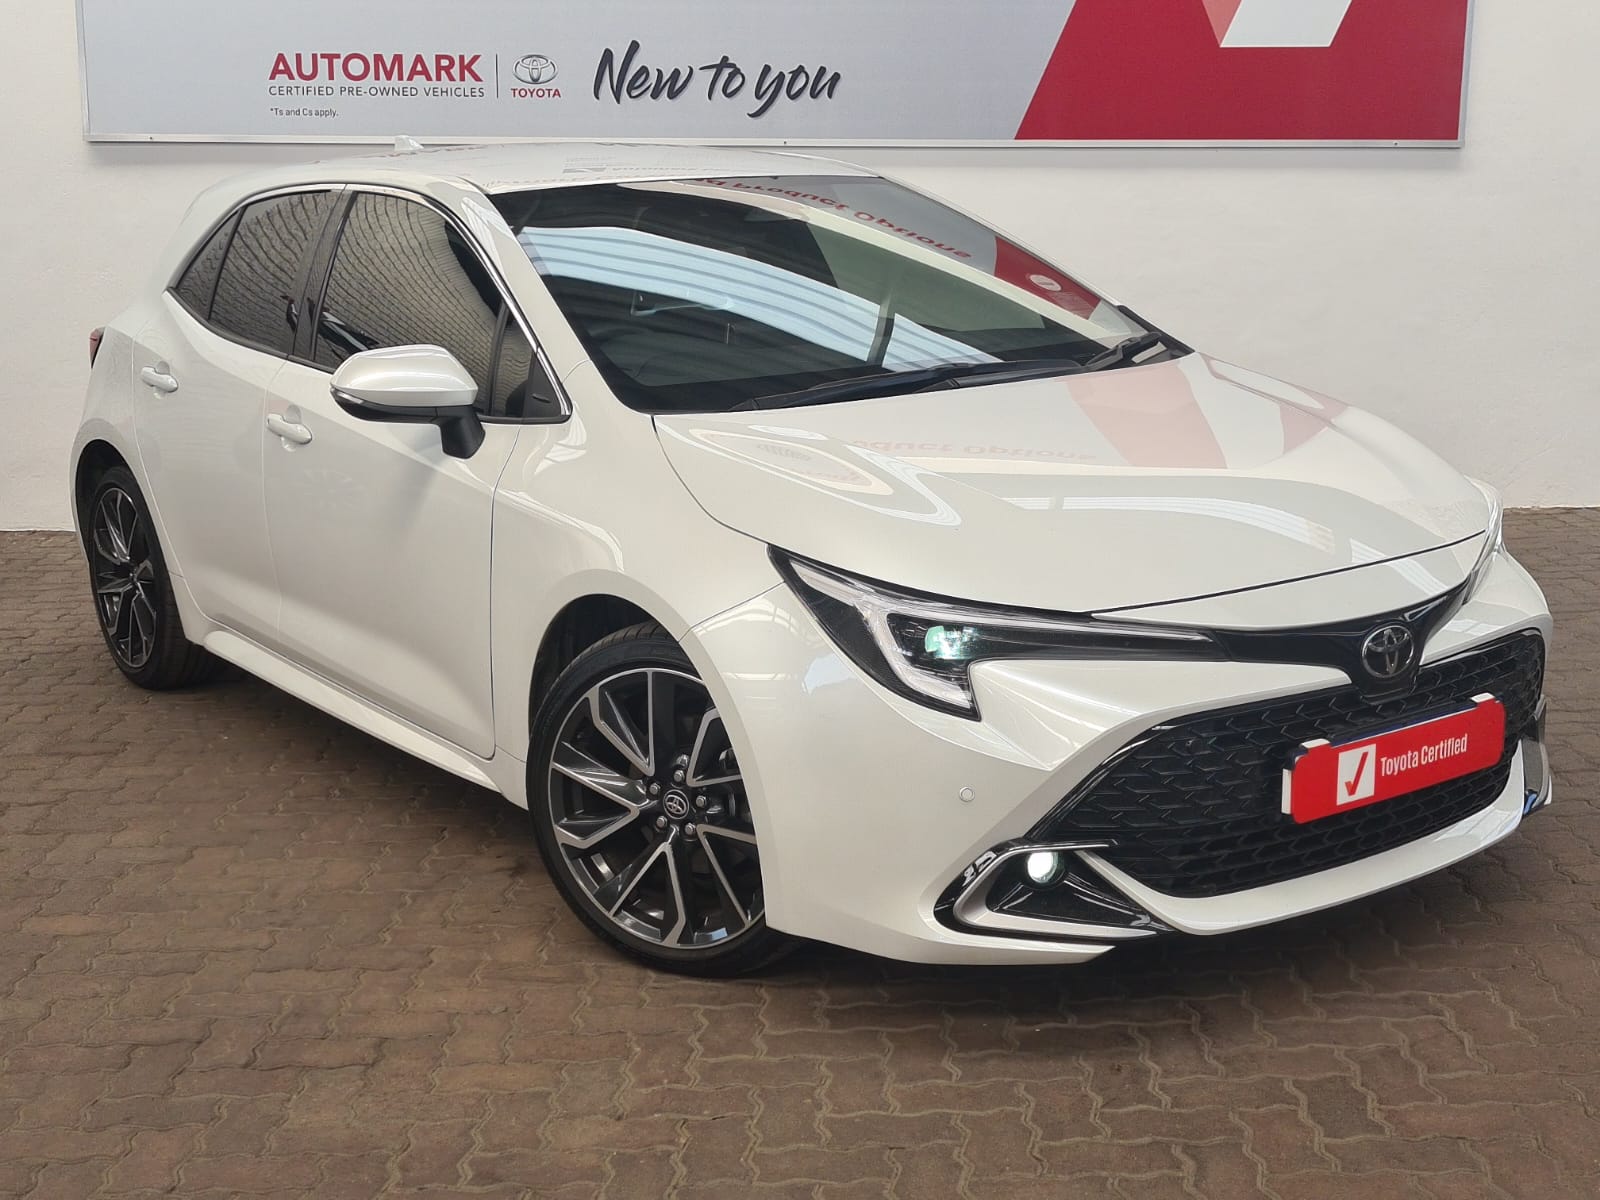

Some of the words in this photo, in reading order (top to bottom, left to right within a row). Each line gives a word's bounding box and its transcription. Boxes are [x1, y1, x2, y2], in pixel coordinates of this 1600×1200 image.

[268, 52, 483, 82] AUTOMARK
[593, 39, 694, 105] New
[698, 55, 746, 101] to
[746, 63, 842, 118] you
[268, 85, 335, 96] CERTIFIED
[339, 85, 419, 97] PRE-OWNED
[423, 86, 485, 98] VEHICLES
[510, 87, 561, 99] TOYOTA
[285, 107, 301, 117] and
[302, 108, 313, 118] Cs
[314, 108, 339, 118] apply.
[1380, 751, 1419, 776] Toyota
[1421, 733, 1468, 765] Certified
